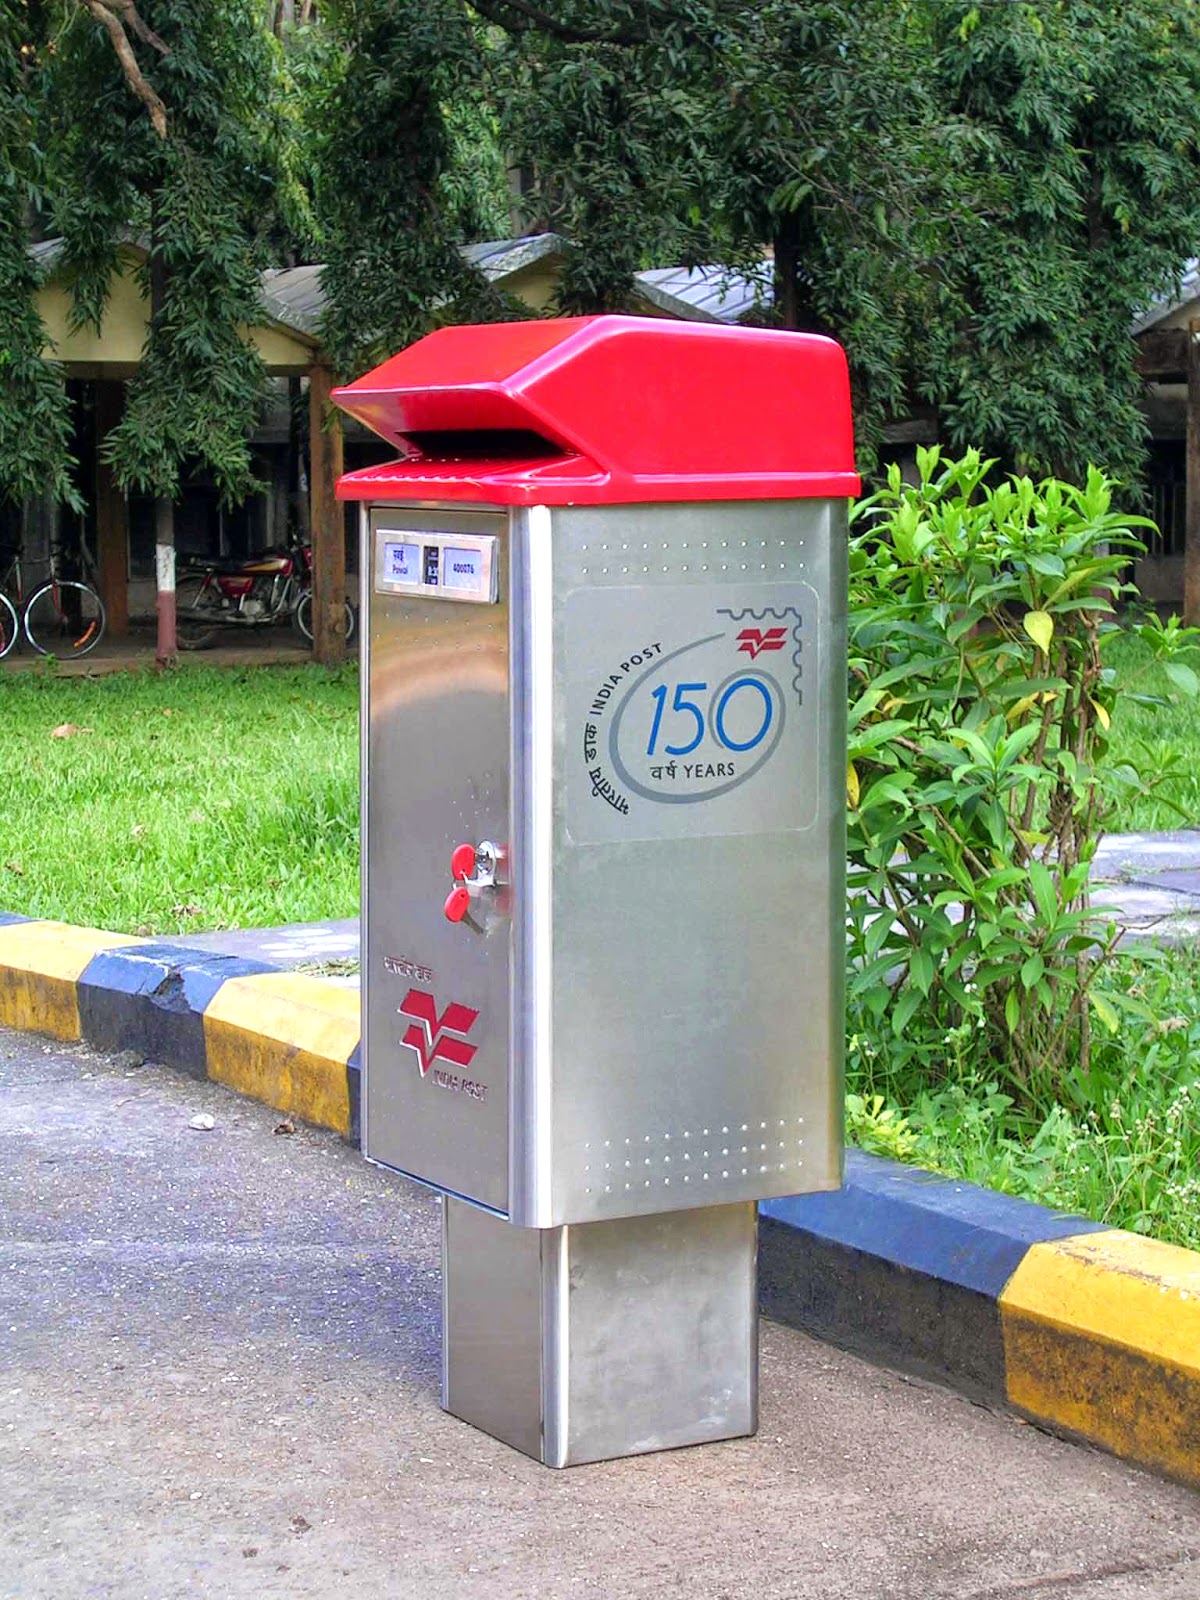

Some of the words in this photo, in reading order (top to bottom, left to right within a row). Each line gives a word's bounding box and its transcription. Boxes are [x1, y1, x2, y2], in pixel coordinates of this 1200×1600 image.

[589, 673, 623, 716] INDIA
[619, 642, 663, 673] POST
[646, 677, 773, 756] 150
[584, 722, 598, 763] डाक
[650, 760, 678, 779] वर्ष
[683, 762, 735, 779] YEARS
[588, 766, 630, 816] भारतीय
[461, 1078, 489, 1103] POST
